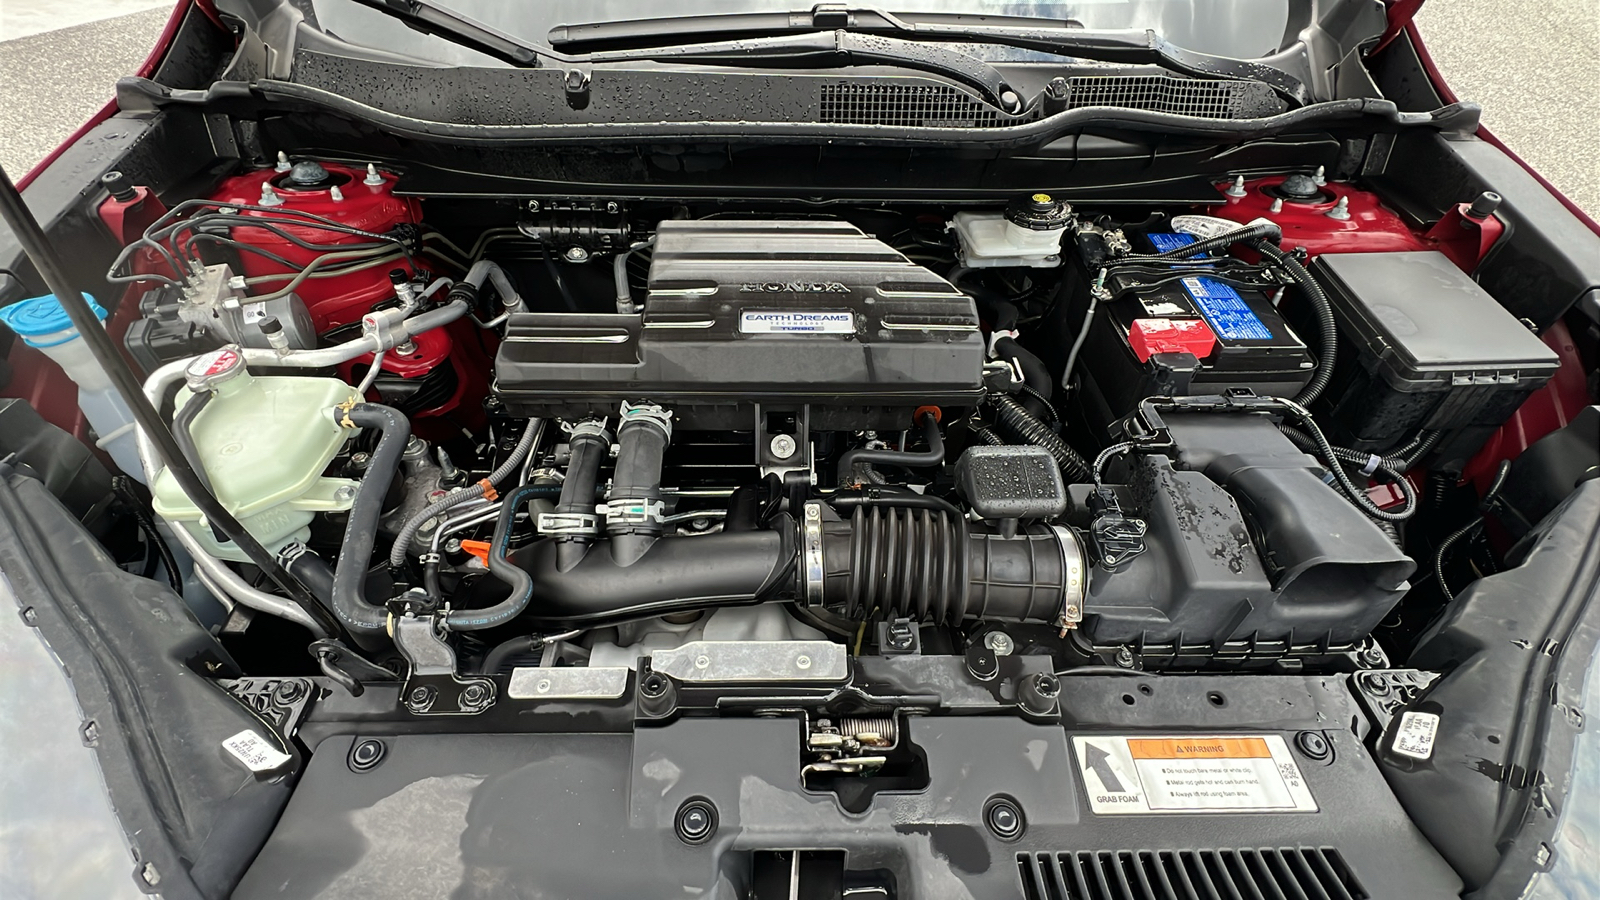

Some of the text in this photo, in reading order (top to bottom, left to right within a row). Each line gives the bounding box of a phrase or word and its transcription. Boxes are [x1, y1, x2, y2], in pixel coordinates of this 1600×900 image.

[740, 282, 851, 293] HONDA
[793, 313, 849, 321] DREAMS
[259, 514, 290, 534] MIN
[1185, 745, 1224, 753] WARNING
[1096, 795, 1140, 803] GRAB FOAM
